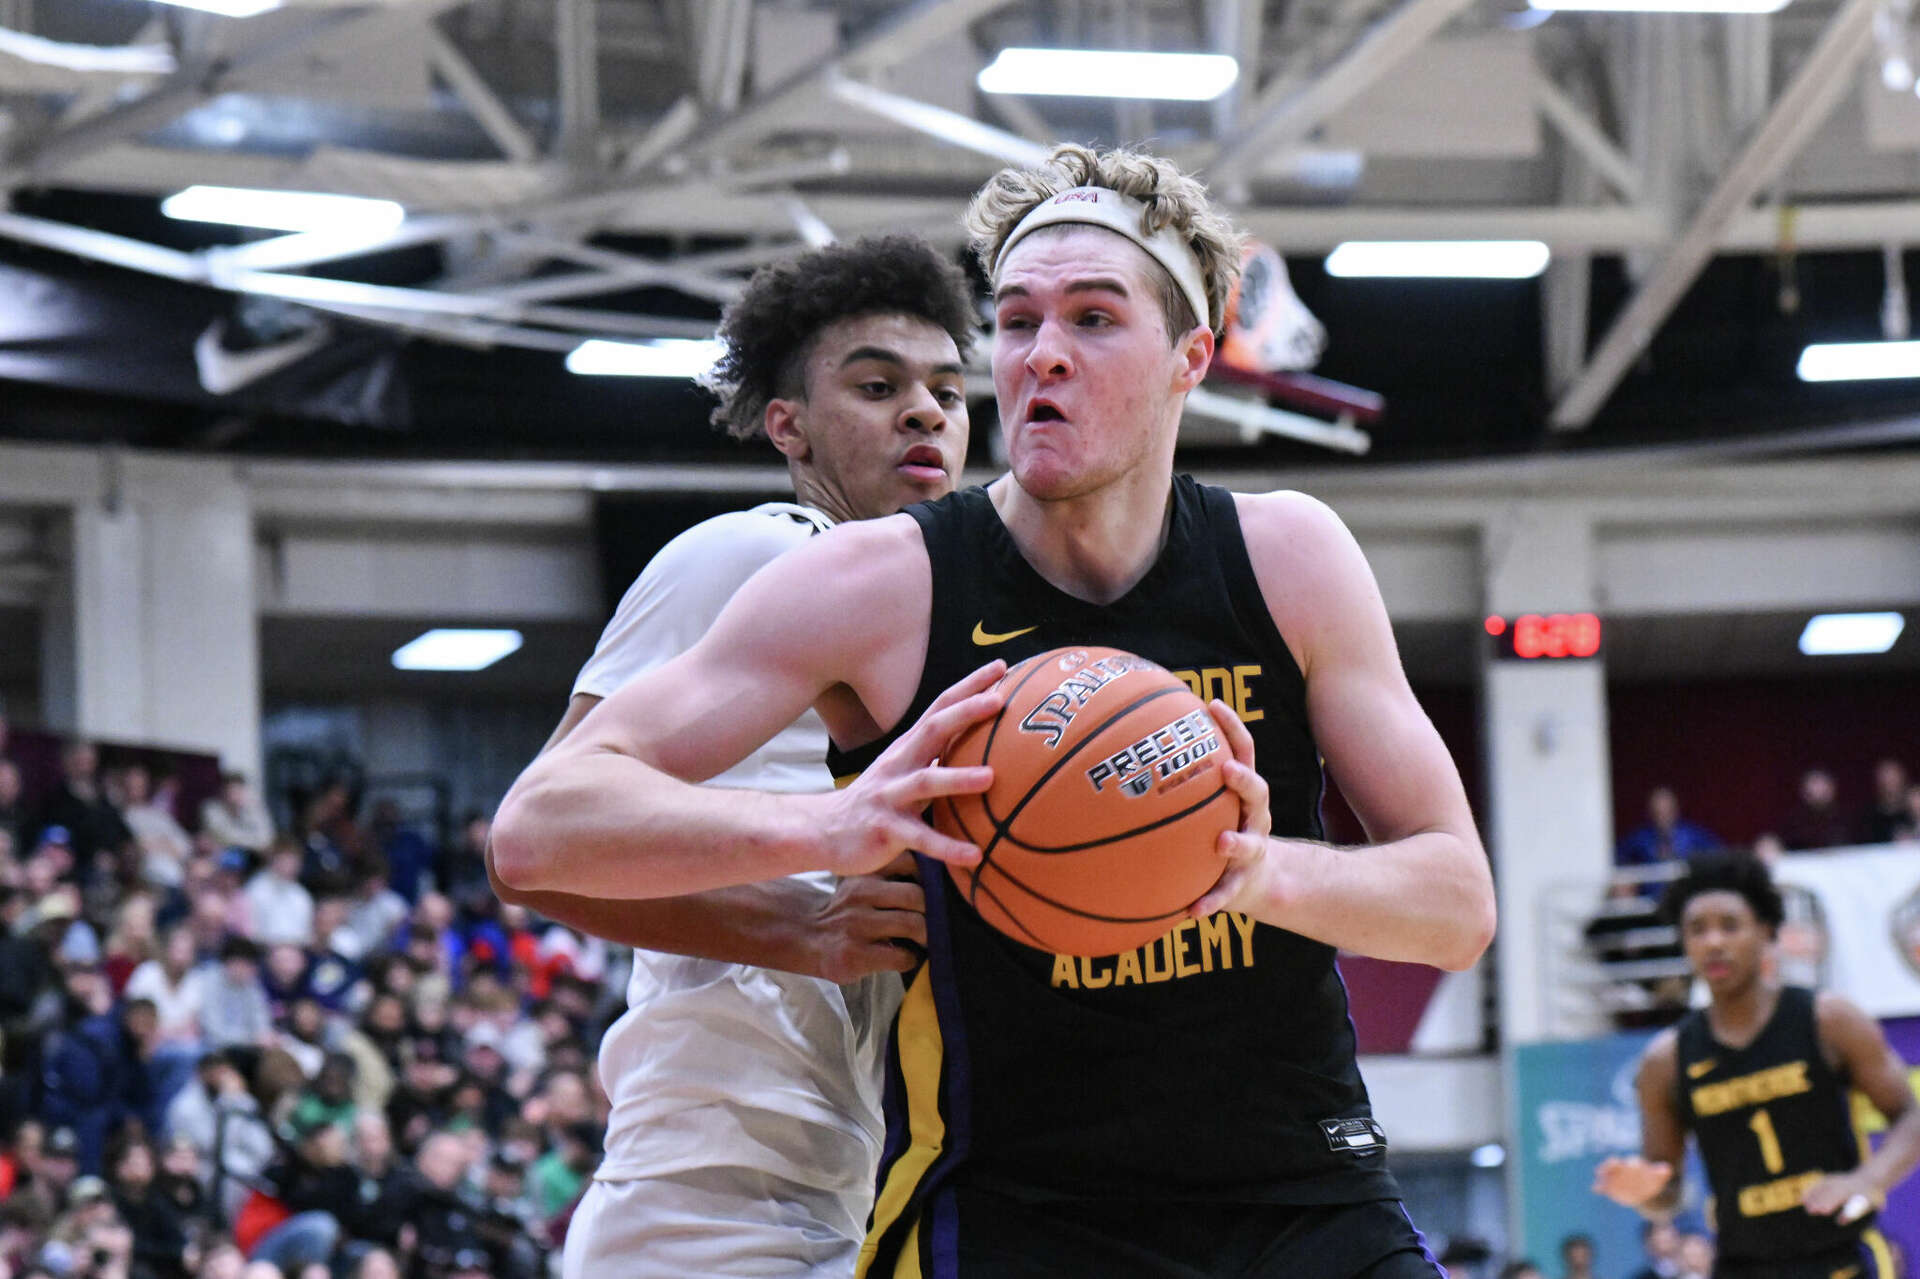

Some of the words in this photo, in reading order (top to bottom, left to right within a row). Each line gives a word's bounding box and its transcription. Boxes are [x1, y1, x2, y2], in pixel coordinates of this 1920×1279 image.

[1155, 733, 1219, 780] 1000
[1051, 911, 1257, 989] ACADEMY
[1750, 1109, 1785, 1174] 1
